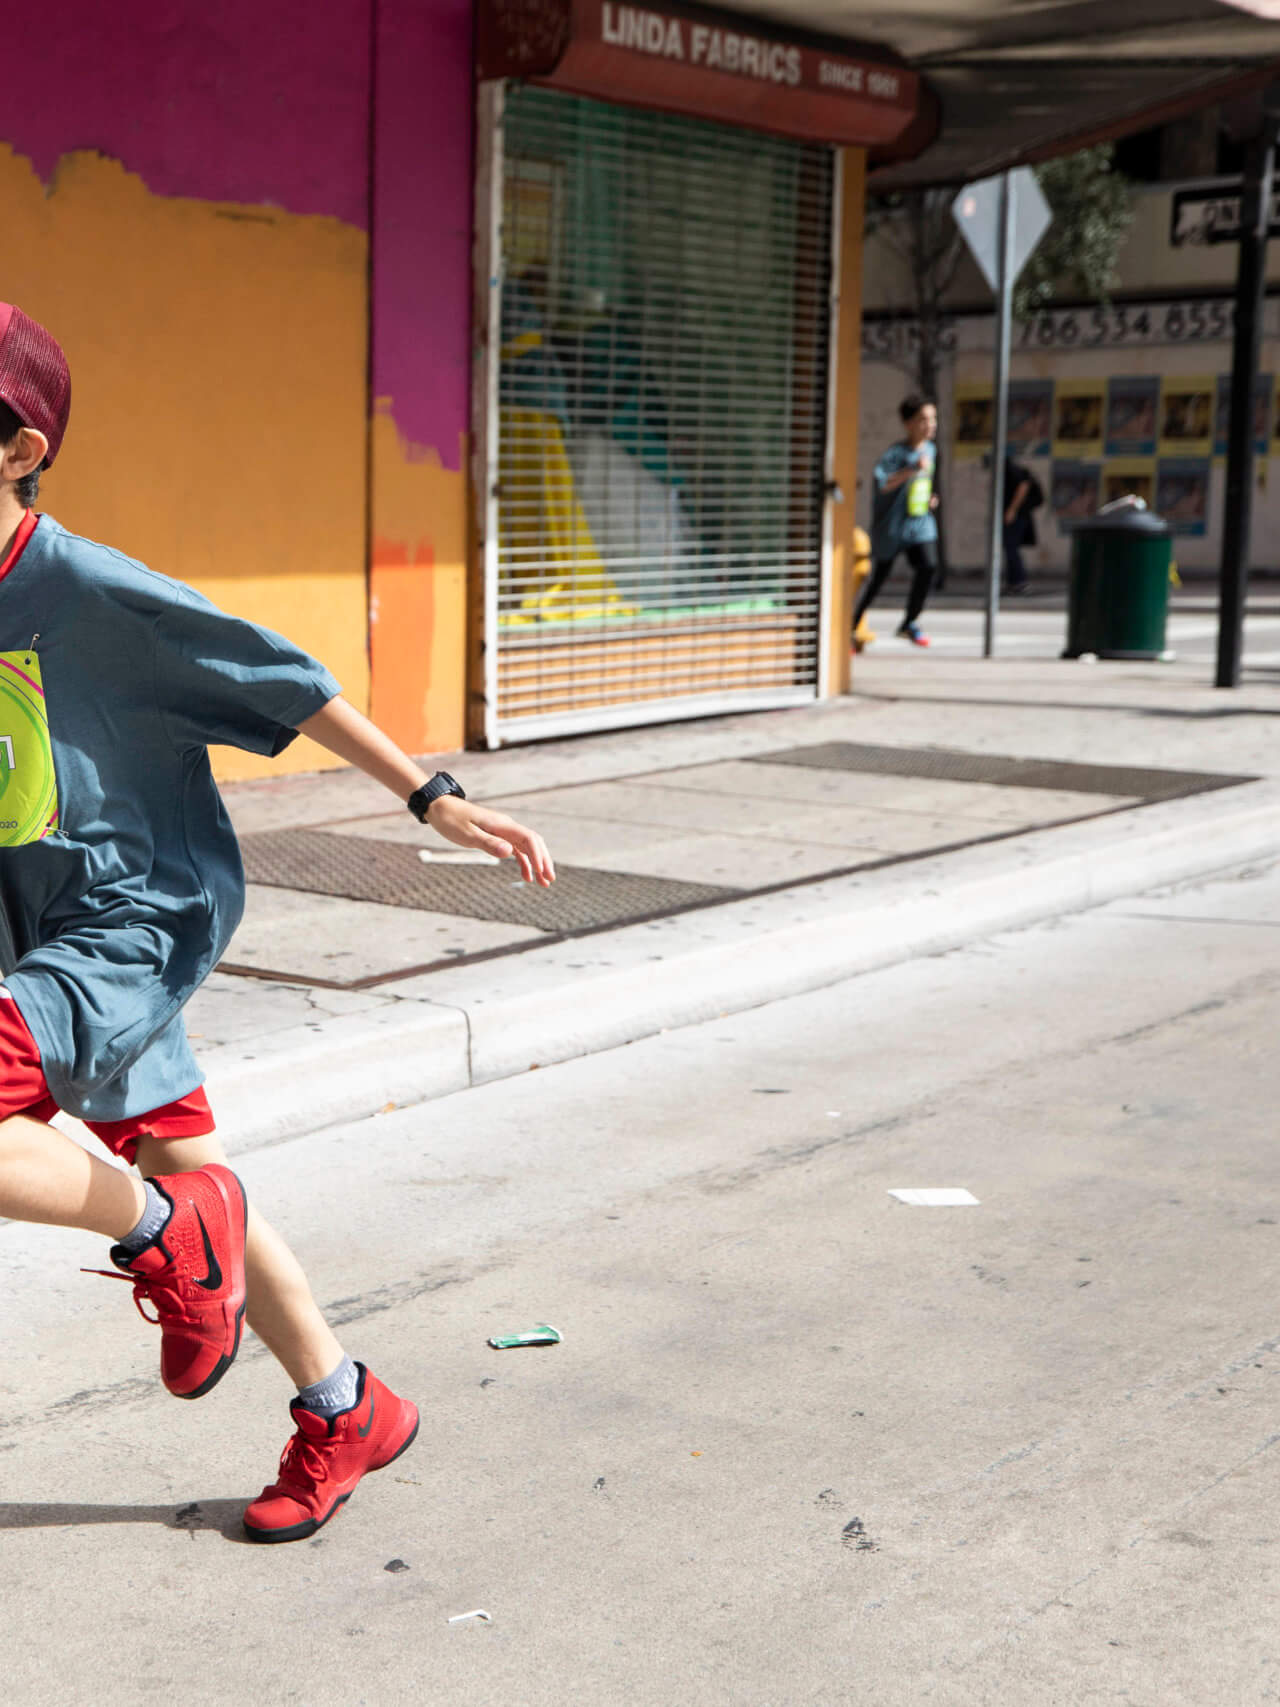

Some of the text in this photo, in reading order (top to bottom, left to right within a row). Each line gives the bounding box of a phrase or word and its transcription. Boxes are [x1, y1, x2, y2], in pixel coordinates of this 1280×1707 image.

[602, 2, 683, 58] LINDA
[692, 26, 801, 84] FABRICS
[820, 61, 863, 91] SINCE
